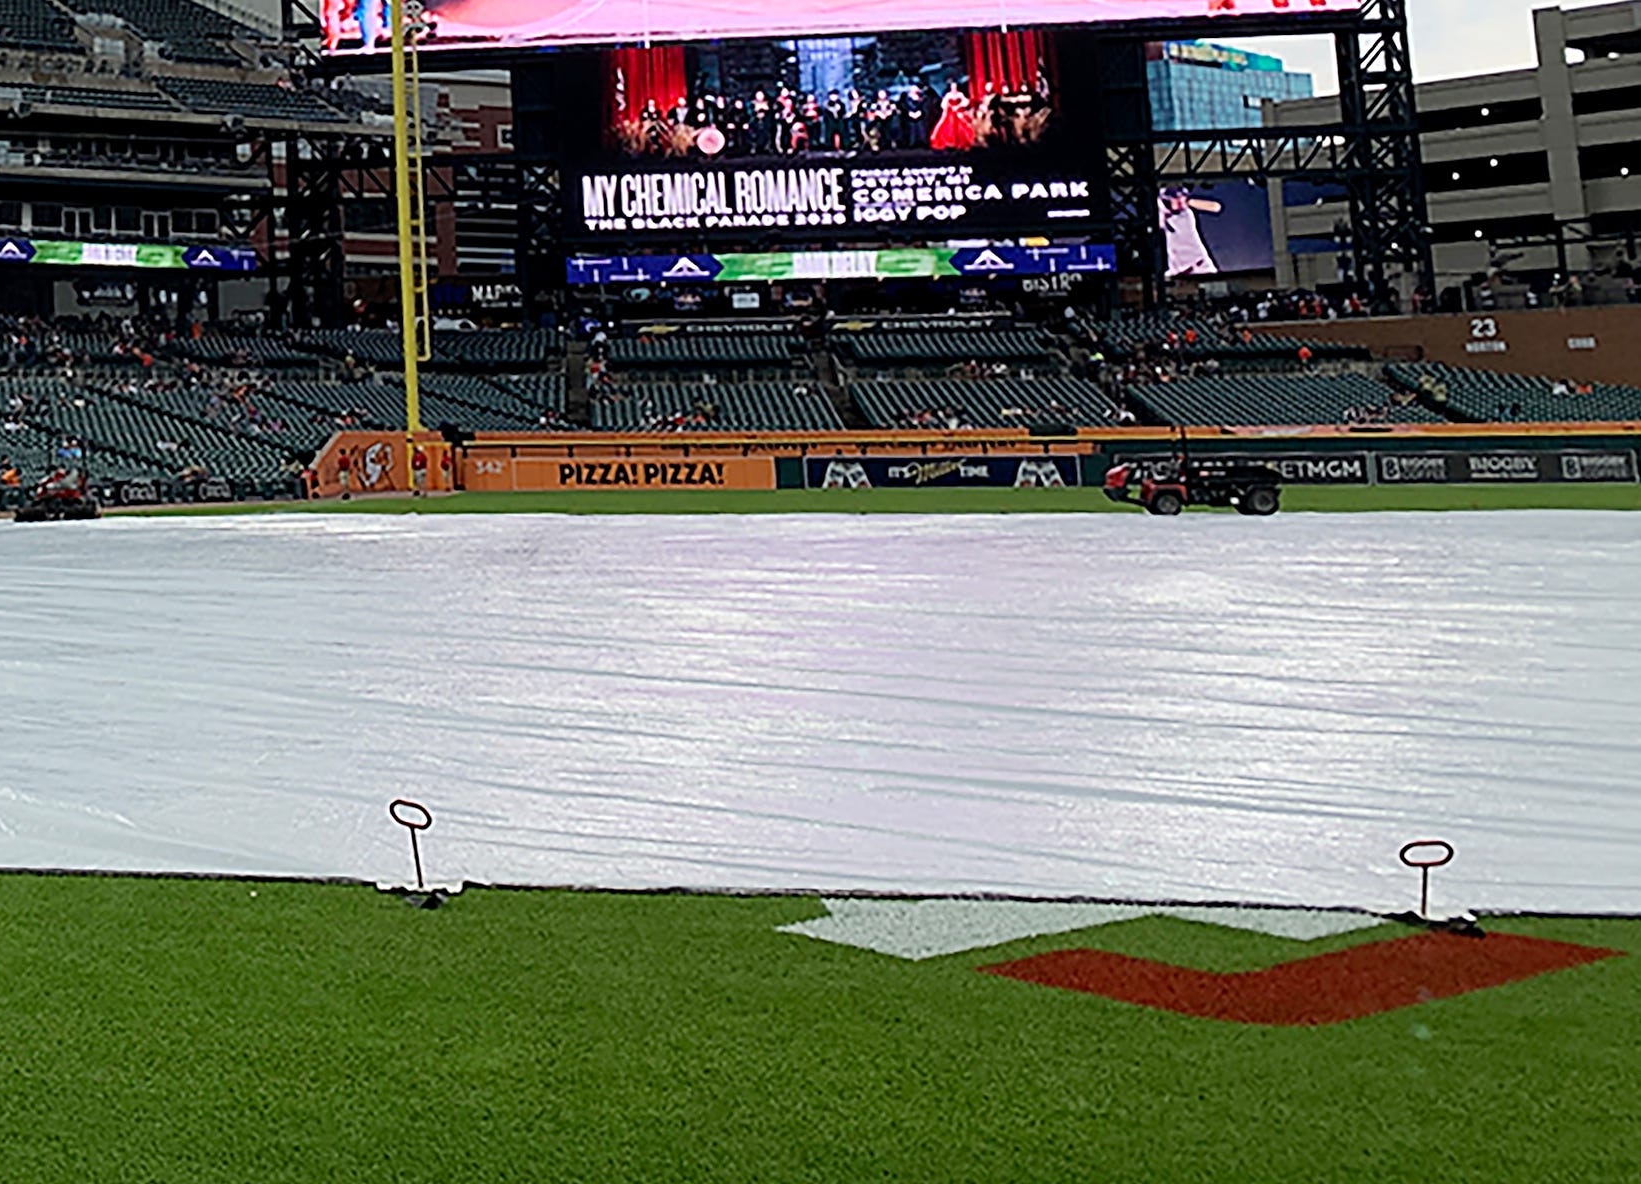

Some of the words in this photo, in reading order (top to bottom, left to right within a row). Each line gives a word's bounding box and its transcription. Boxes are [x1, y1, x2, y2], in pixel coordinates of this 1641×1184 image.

[582, 174, 617, 218] MY
[621, 171, 732, 217] CHEMICAL
[734, 168, 846, 214] ROMANCE
[852, 184, 1003, 202] COMERICA
[1011, 181, 1089, 199] PARK
[584, 218, 626, 230] THE
[632, 216, 700, 229] BLACK
[705, 214, 790, 227] PARADE
[853, 205, 911, 222] IGGY
[916, 204, 966, 220] POP
[1470, 318, 1497, 337] 23
[559, 463, 638, 485] PIZZA!
[644, 462, 725, 485] PIZZA!
